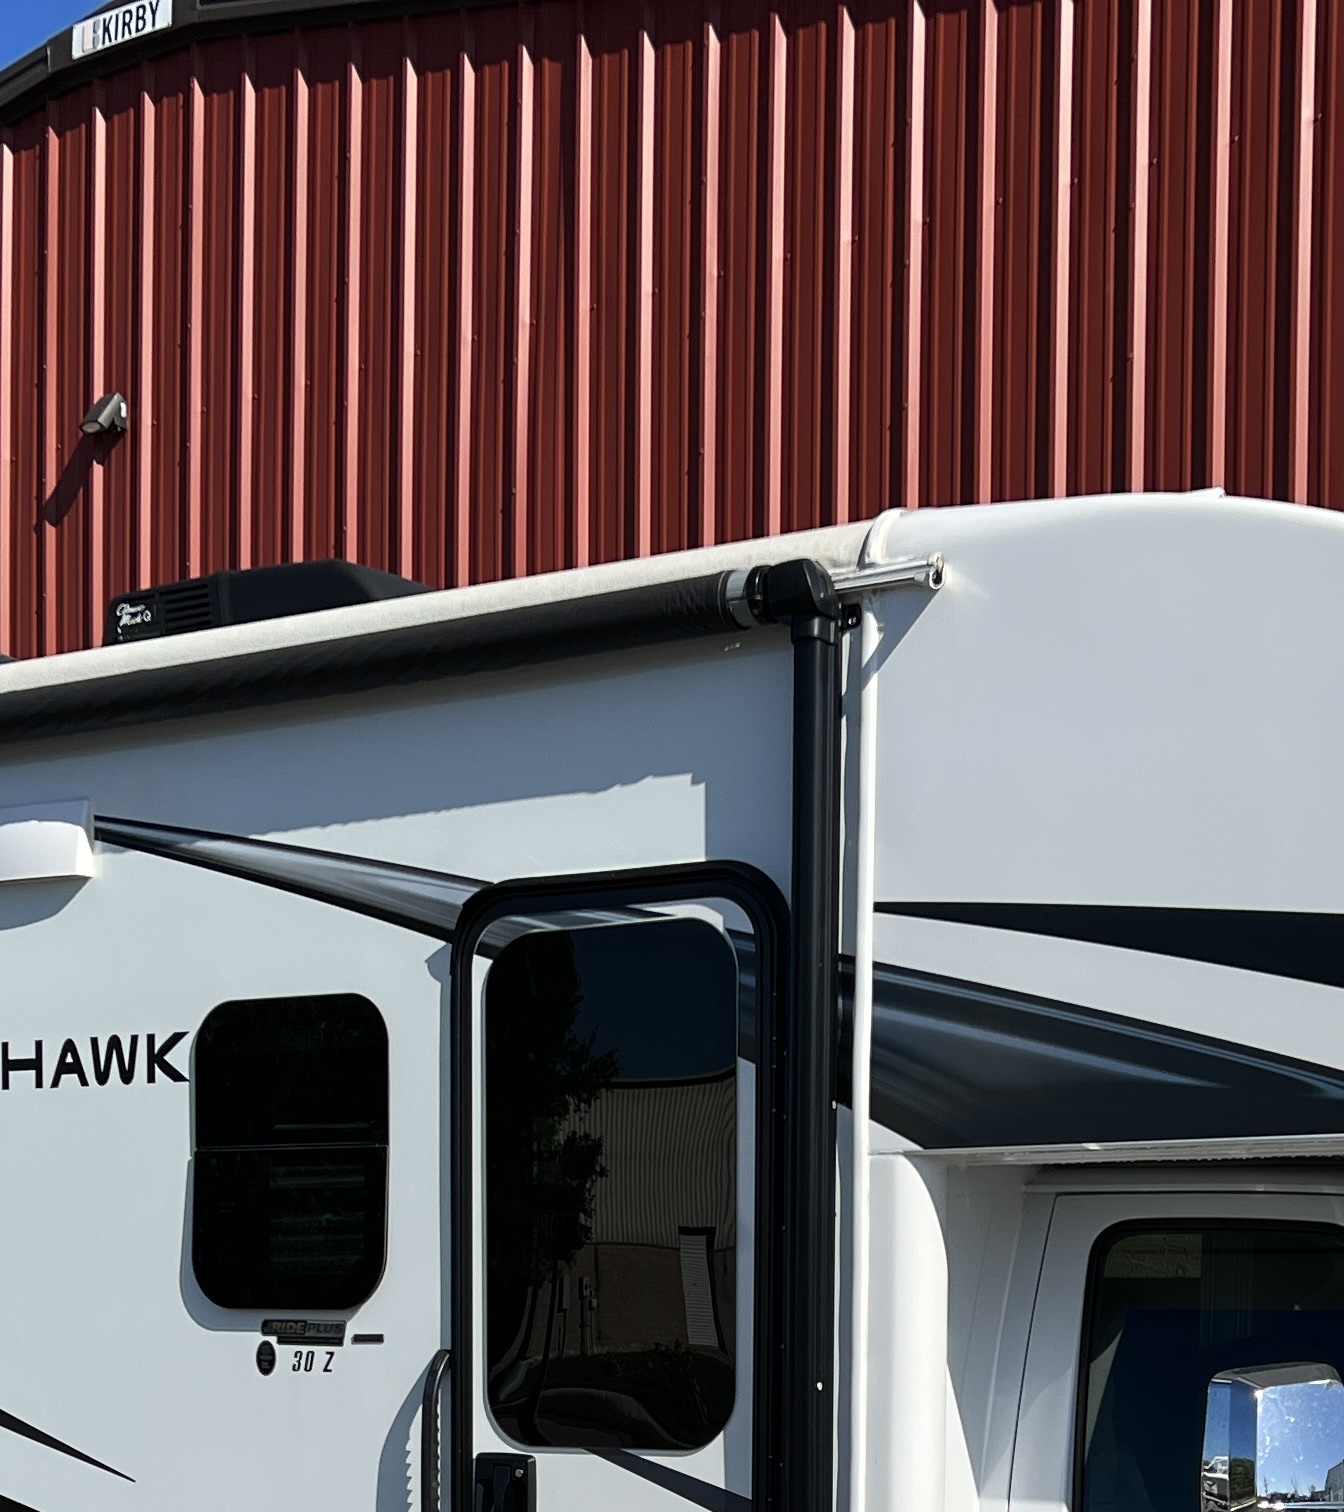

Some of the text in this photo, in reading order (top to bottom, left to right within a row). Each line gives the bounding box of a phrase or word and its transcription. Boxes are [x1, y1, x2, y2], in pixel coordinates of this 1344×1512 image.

[102, 2, 160, 46] KIRBY
[307, 1322, 344, 1334] PLUS
[292, 1350, 315, 1373] 30
[323, 1350, 336, 1373] Z
